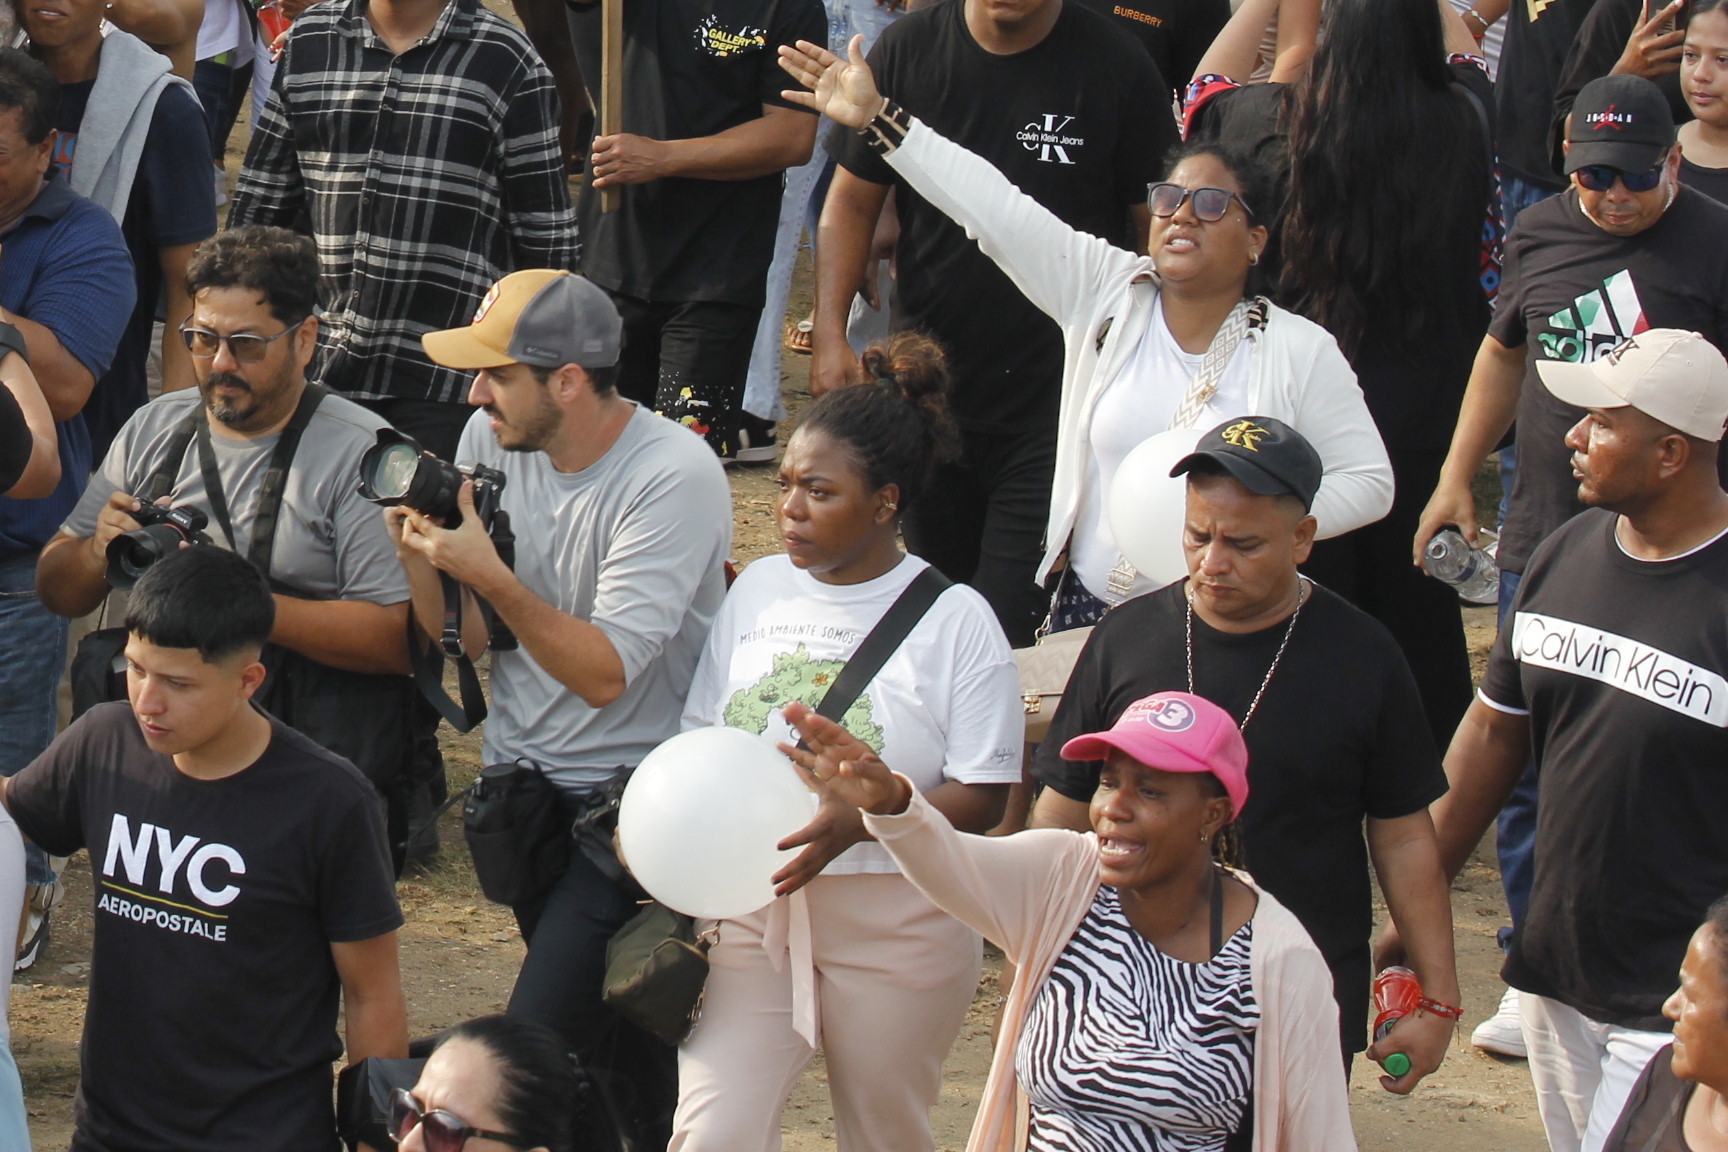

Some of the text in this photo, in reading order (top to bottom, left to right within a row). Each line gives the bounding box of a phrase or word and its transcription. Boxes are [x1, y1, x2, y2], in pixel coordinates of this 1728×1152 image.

[1113, 5, 1164, 28] BURBERRY
[708, 28, 753, 48] GALLERY
[1016, 131, 1084, 147] Calvin Klein Jeans
[1022, 113, 1076, 165] CK
[171, 512, 189, 525] SONY
[739, 626, 856, 645] MEDIO AMBIENTE SOMOS
[1519, 617, 1714, 717] Calvin Klein
[1157, 701, 1190, 728] 3
[102, 813, 246, 908] NYC
[98, 891, 228, 943] AEROPOSTALE
